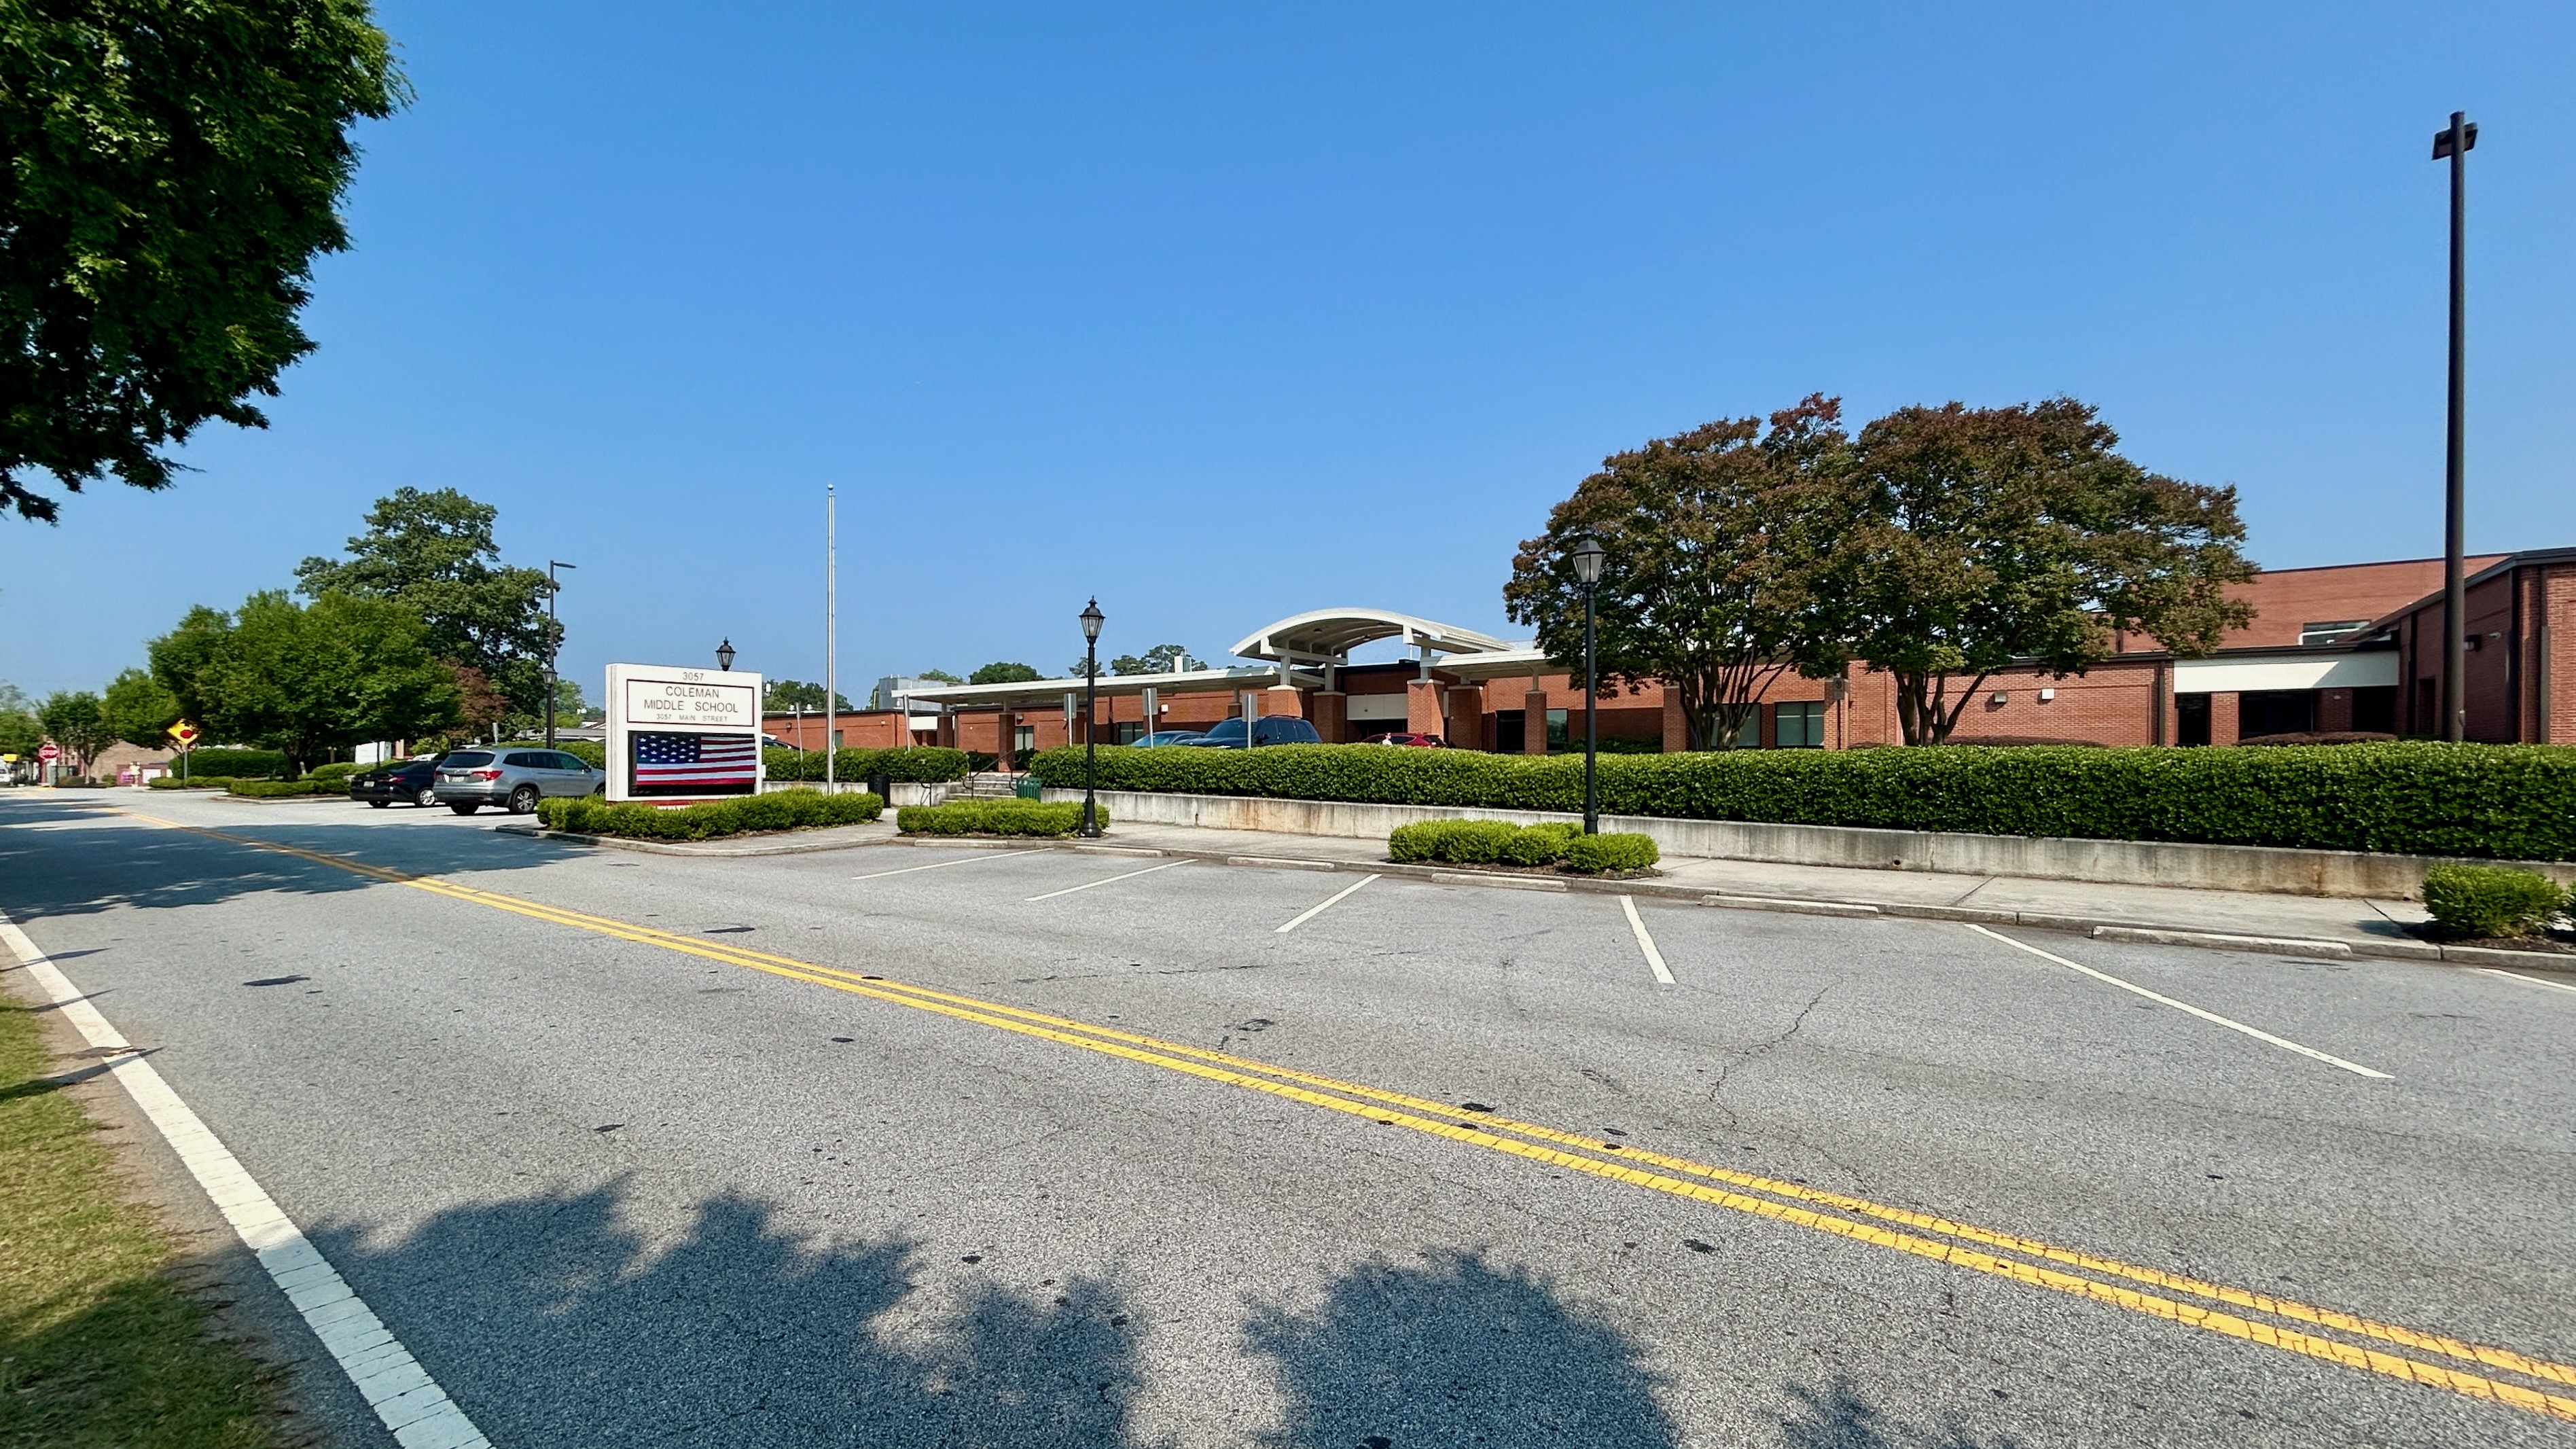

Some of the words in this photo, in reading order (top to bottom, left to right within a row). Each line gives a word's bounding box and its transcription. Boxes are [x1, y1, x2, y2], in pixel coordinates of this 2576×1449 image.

[683, 672, 704, 681] 3057
[666, 686, 719, 698] COLEMAN
[644, 699, 684, 711] MIDDLE
[695, 701, 738, 713] SCHOOL
